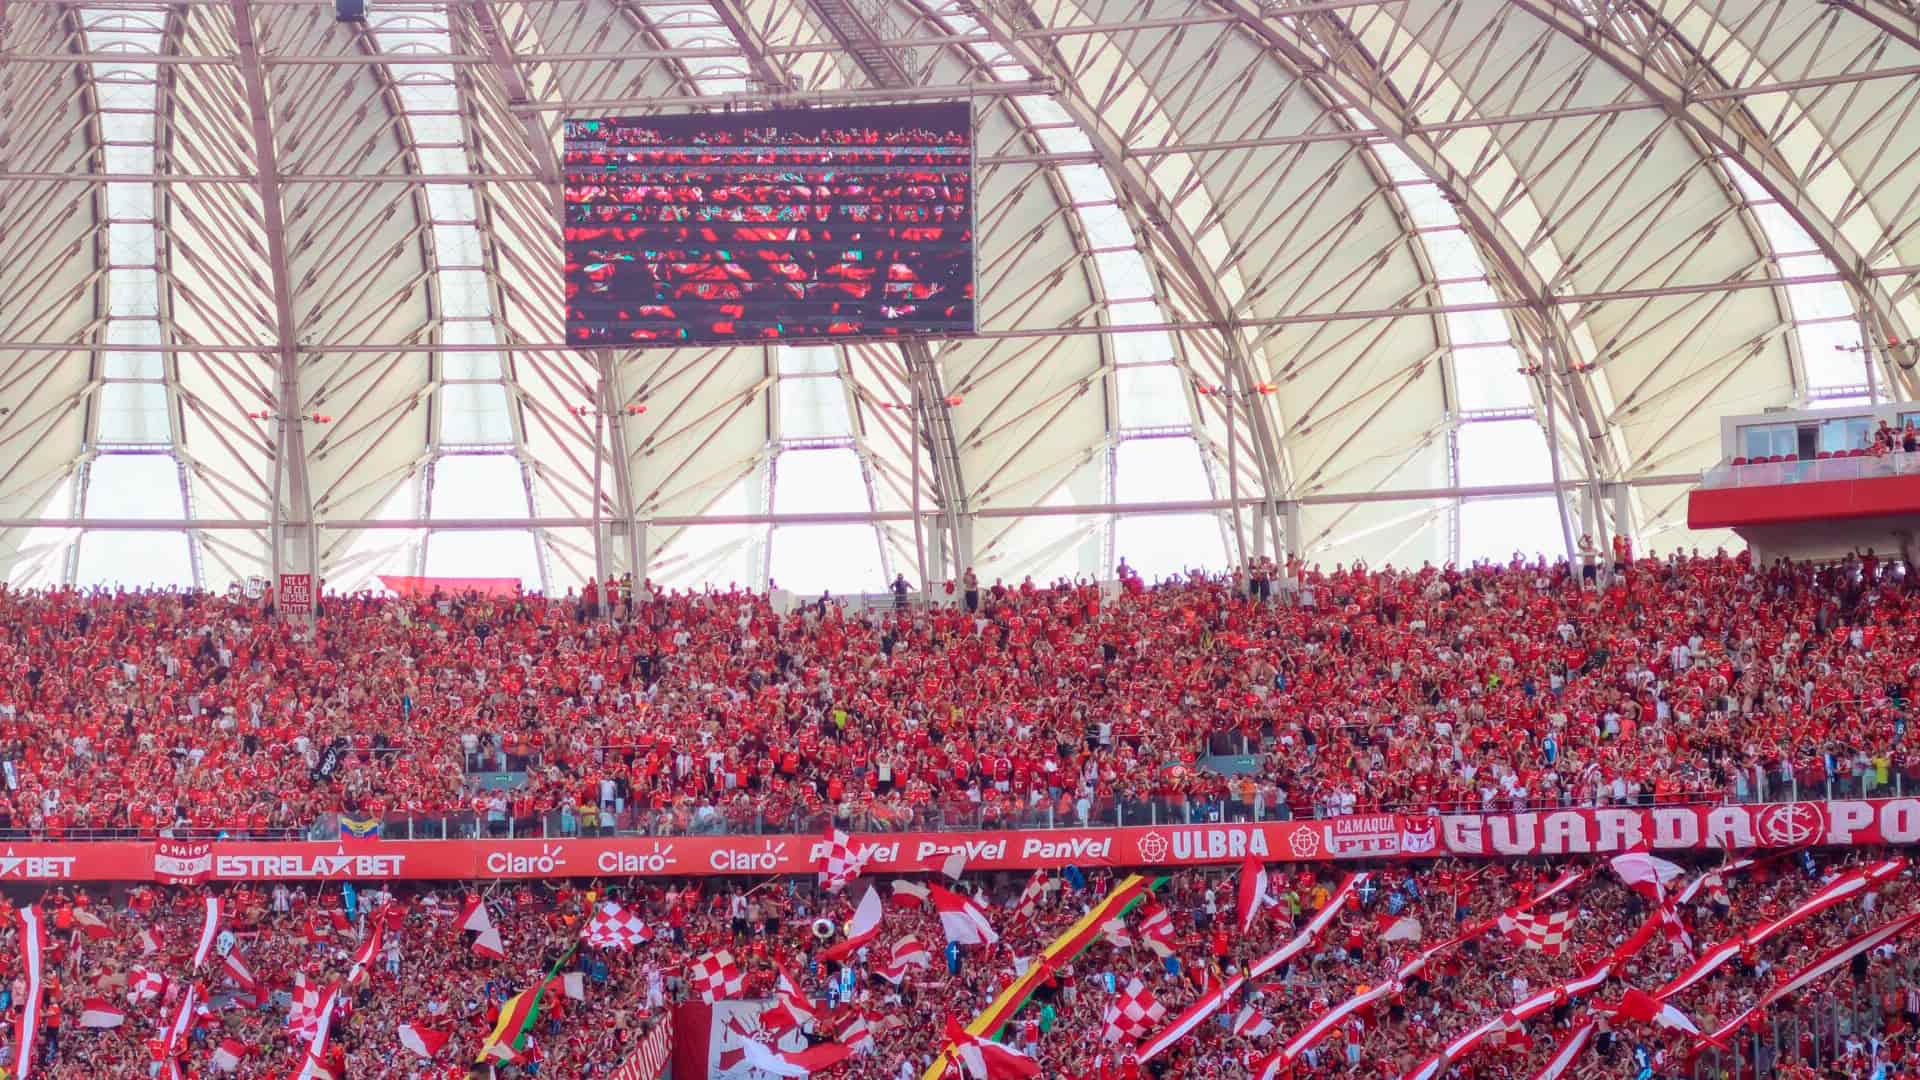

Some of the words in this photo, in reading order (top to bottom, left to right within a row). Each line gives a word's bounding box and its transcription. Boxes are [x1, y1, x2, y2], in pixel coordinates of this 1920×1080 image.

[1442, 807, 1756, 855] GUARDA
[1172, 829, 1269, 858] ULBRA
[487, 851, 554, 873] Claro
[597, 850, 665, 872] Claro
[710, 848, 777, 870] Claro
